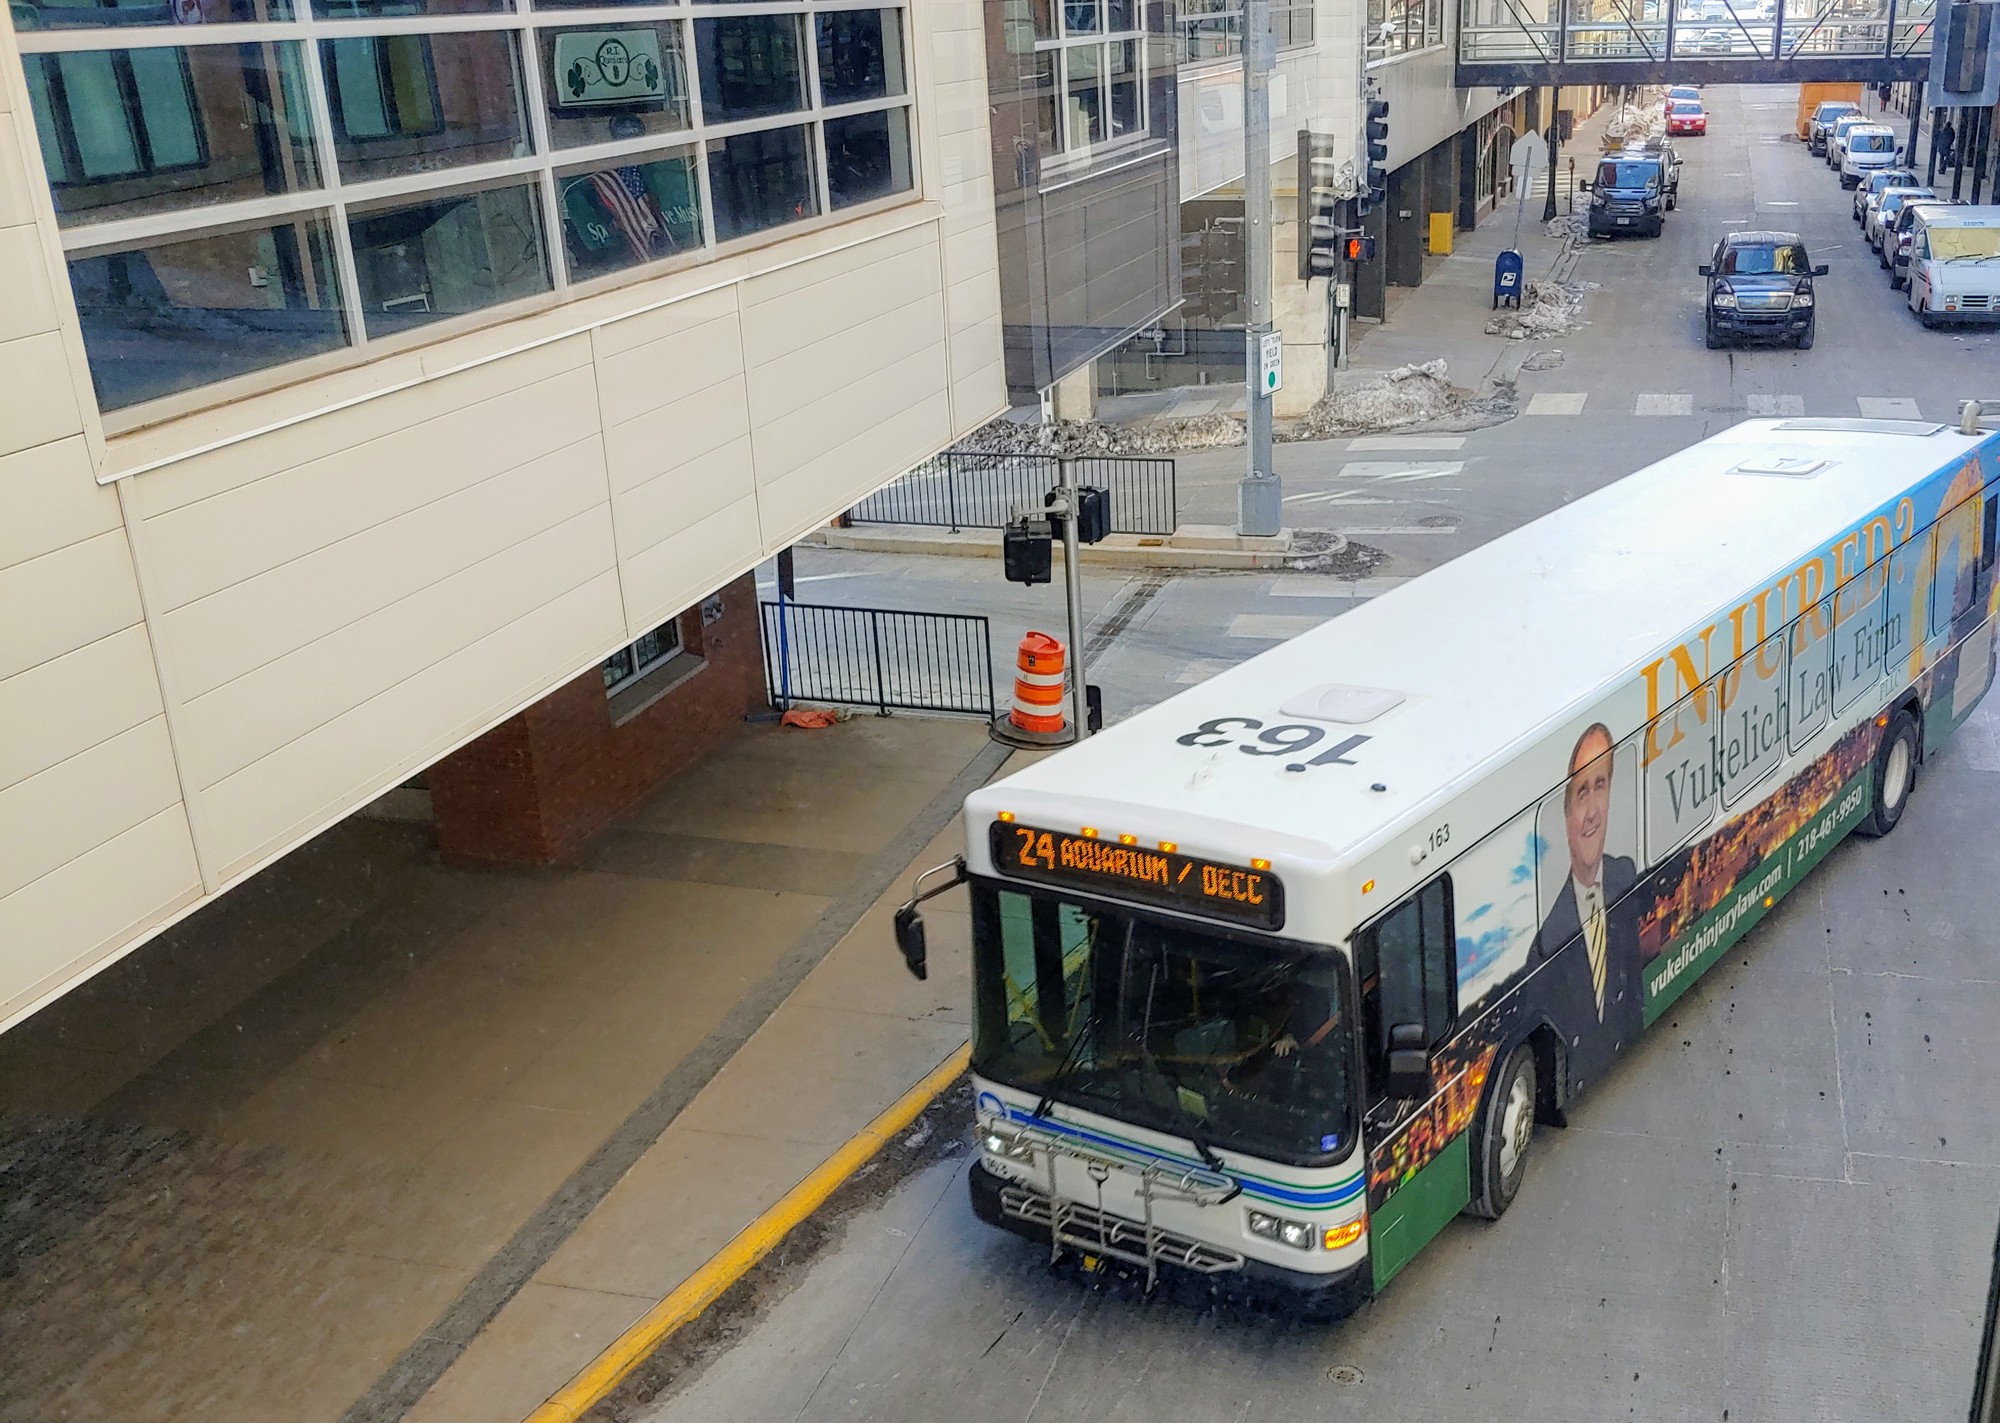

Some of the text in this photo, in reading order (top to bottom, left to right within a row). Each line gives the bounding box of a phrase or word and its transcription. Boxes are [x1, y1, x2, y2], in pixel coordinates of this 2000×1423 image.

[1640, 496, 1914, 768] INJURED?
[1176, 717, 1373, 766] 163
[1665, 612, 1902, 824] Vukelich Law Firm
[1015, 827, 1055, 871] 24
[1060, 836, 1169, 885] AQUARIUM
[1201, 864, 1264, 905] DECC
[1429, 823, 1450, 852] 163
[1650, 864, 1783, 998] vukelichinjurylaw.com
[1796, 785, 1863, 862] 218-461-9950
